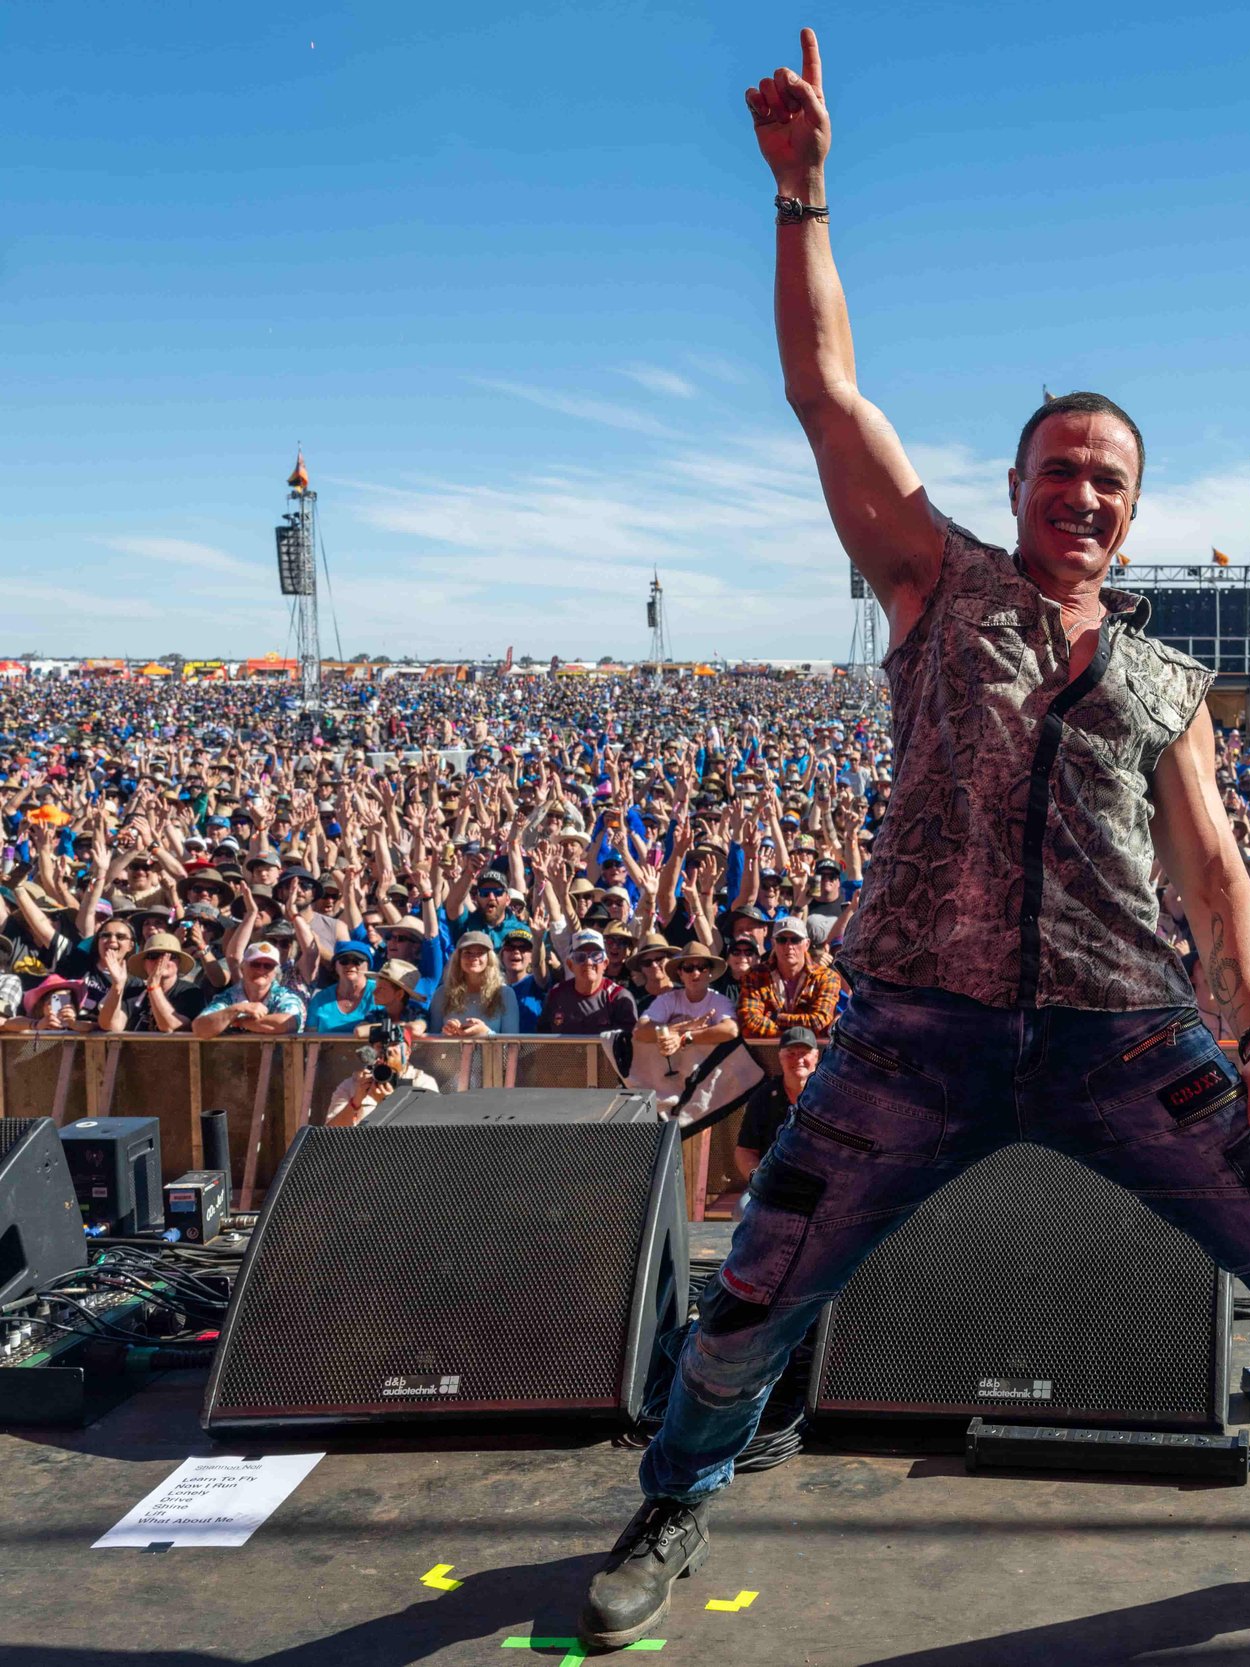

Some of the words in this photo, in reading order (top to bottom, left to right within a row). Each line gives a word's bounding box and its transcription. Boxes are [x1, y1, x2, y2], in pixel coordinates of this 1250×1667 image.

[384, 1376, 406, 1387] d&b
[979, 1378, 1000, 1388] d&b
[383, 1385, 438, 1396] audiotechnik
[978, 1387, 1031, 1398] audiotechnik
